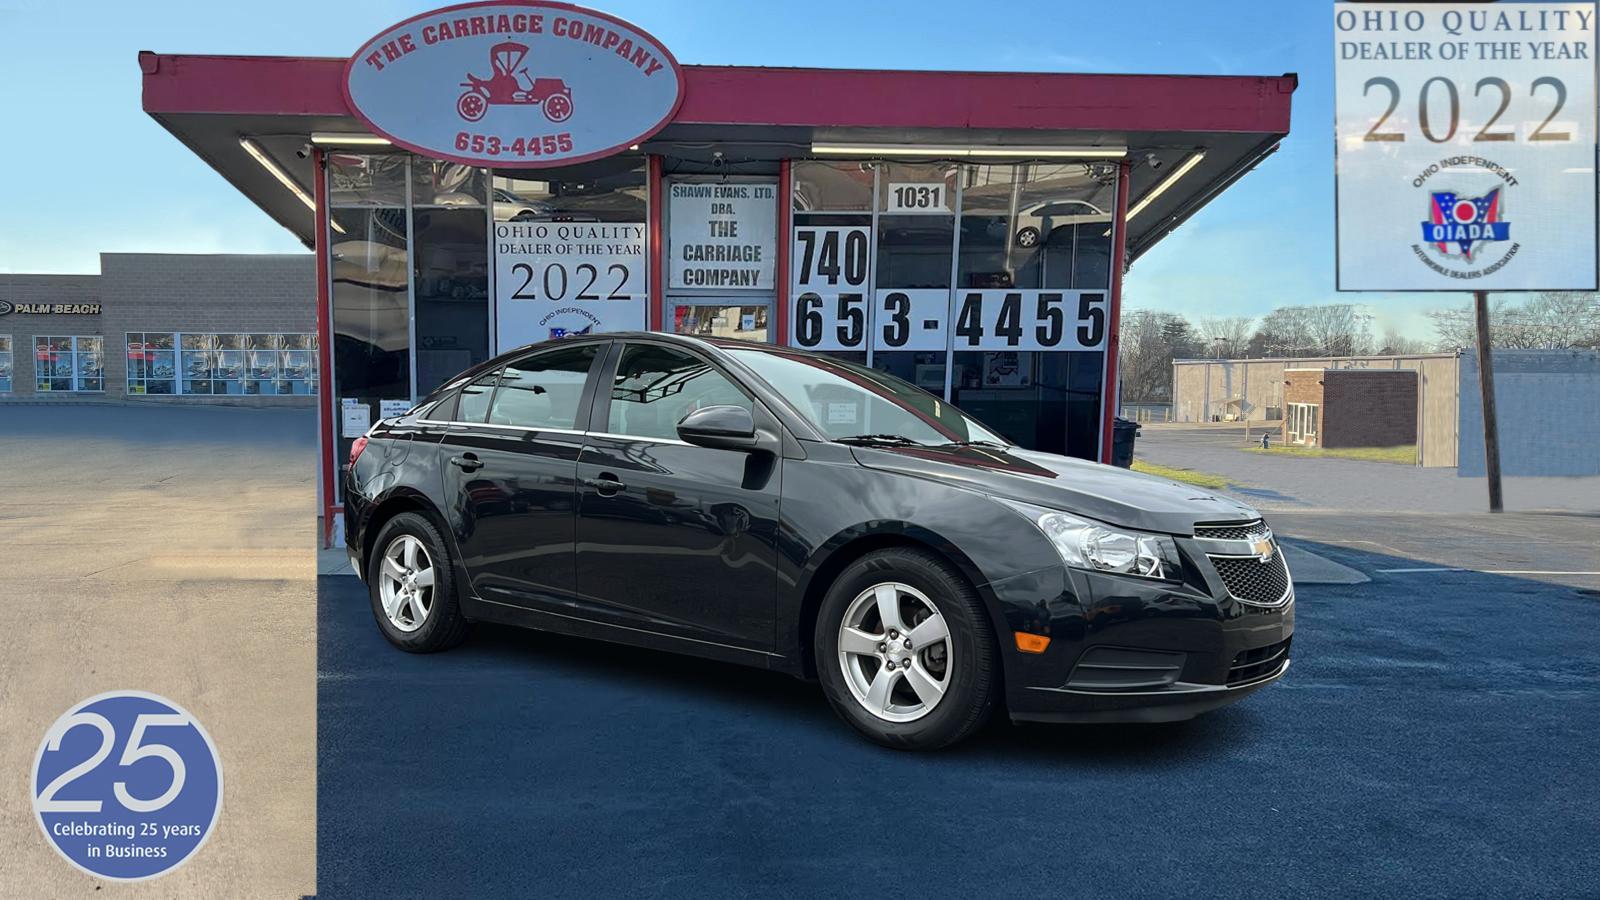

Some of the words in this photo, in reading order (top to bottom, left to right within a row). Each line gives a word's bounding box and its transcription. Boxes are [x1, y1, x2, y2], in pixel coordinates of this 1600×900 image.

[1336, 10, 1425, 31] OHIO
[1442, 10, 1593, 35] QUALITY
[366, 34, 416, 72] THE
[422, 14, 543, 45] CARRIAGE
[552, 17, 664, 77] COMPANY
[1340, 42, 1433, 60] DEALER
[1439, 42, 1469, 60] OF
[1475, 42, 1522, 60] THE
[1528, 42, 1589, 60] YEAR
[1363, 76, 1571, 143] 2022
[455, 132, 573, 157] 653-4455
[1413, 163, 1440, 188] OHIO
[1439, 155, 1519, 187] INDEPENDENT
[672, 186, 712, 198] SHAWN
[754, 187, 774, 199] LTD.
[894, 187, 940, 208] 1031
[711, 203, 735, 215] DBA.
[497, 226, 548, 239] OHIO
[558, 226, 644, 240] QUALITY
[708, 220, 738, 238] THE
[1432, 224, 1495, 240] OIADA
[499, 243, 551, 255] DEALER
[556, 243, 573, 255] OF
[576, 243, 603, 255] THE
[606, 243, 641, 255] YEAR
[682, 244, 762, 262] CARRIAGE
[797, 230, 868, 286] 740
[1411, 243, 1450, 277] AUTOMOBILE
[1448, 268, 1483, 280] DEALERS
[1481, 241, 1521, 277] ASSOCIATION
[510, 263, 632, 301] 2022
[683, 268, 760, 286] COMPANY
[14, 304, 51, 314] PALM
[54, 304, 100, 314] BEACH
[554, 307, 601, 326] INDEPENDENT
